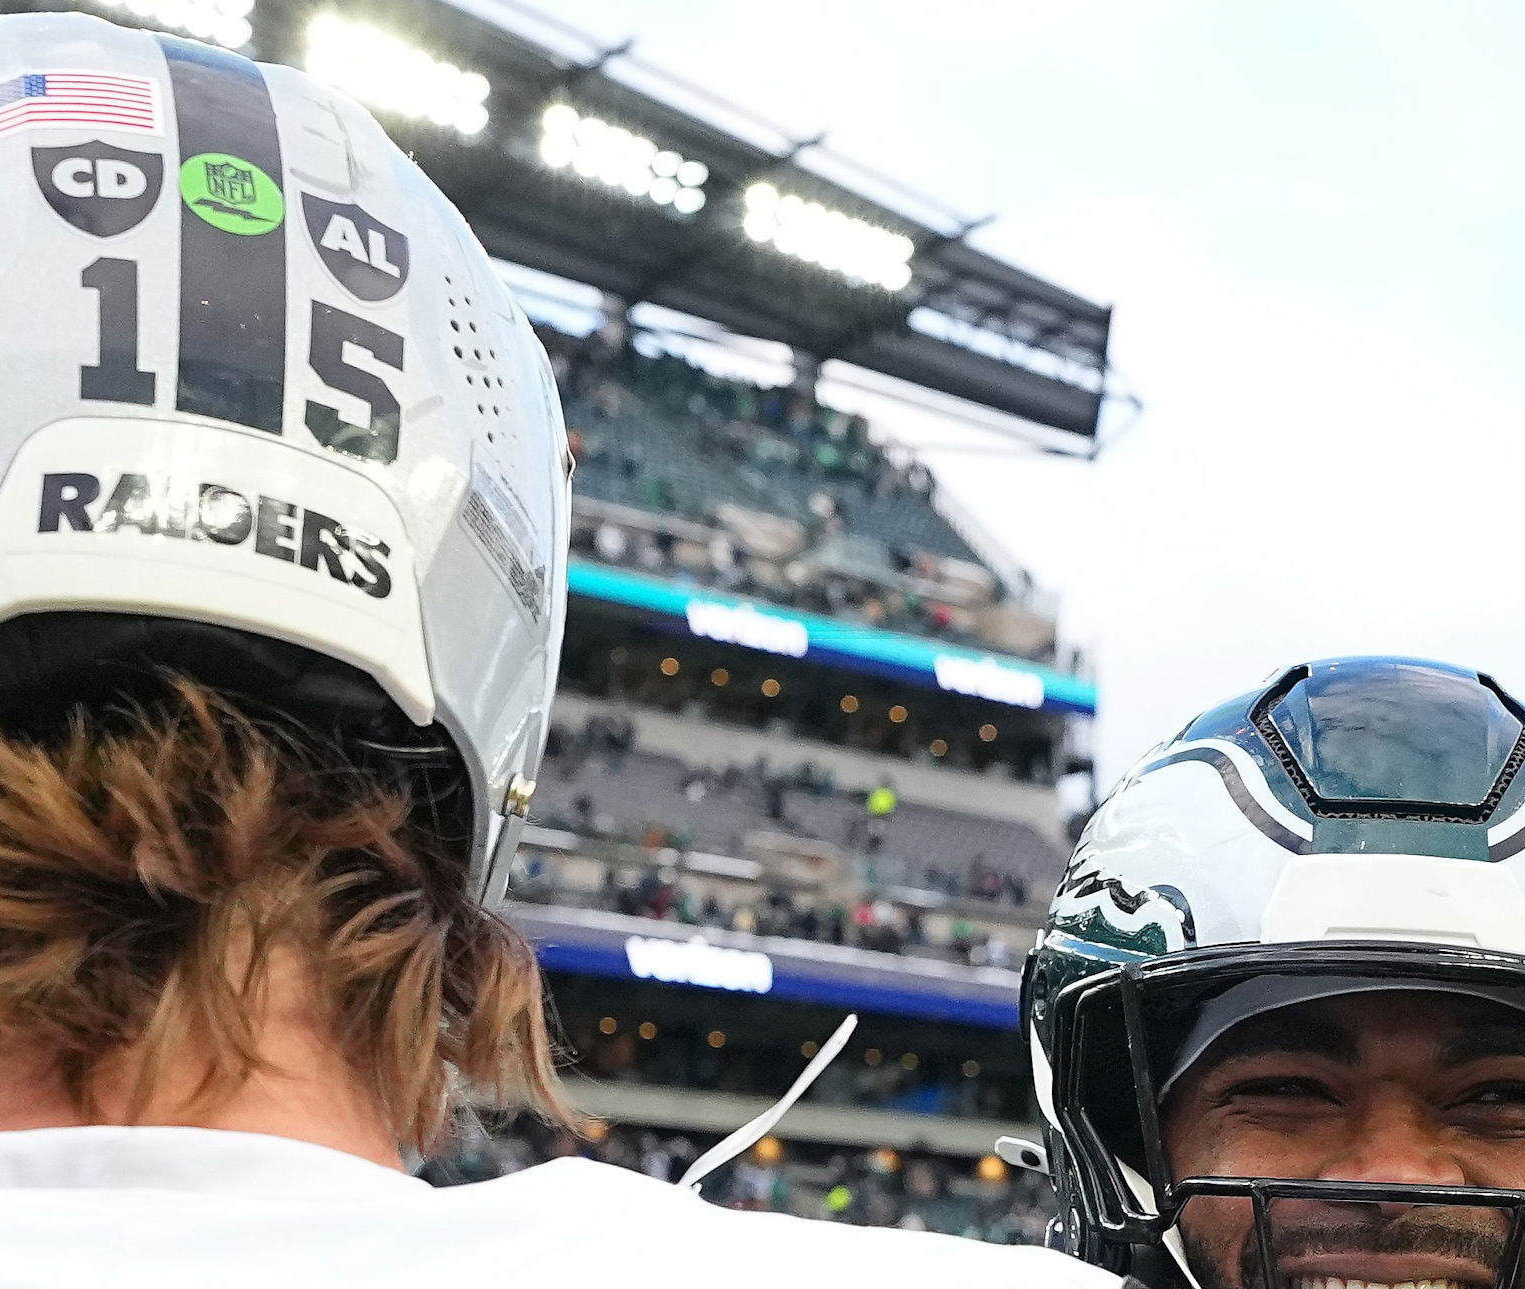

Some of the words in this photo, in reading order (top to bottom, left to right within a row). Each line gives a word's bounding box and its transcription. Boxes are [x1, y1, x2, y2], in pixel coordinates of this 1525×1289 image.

[50, 156, 149, 200] CD
[211, 176, 254, 201] NFL
[319, 213, 402, 279] AL
[38, 472, 392, 599] RAIDERS
